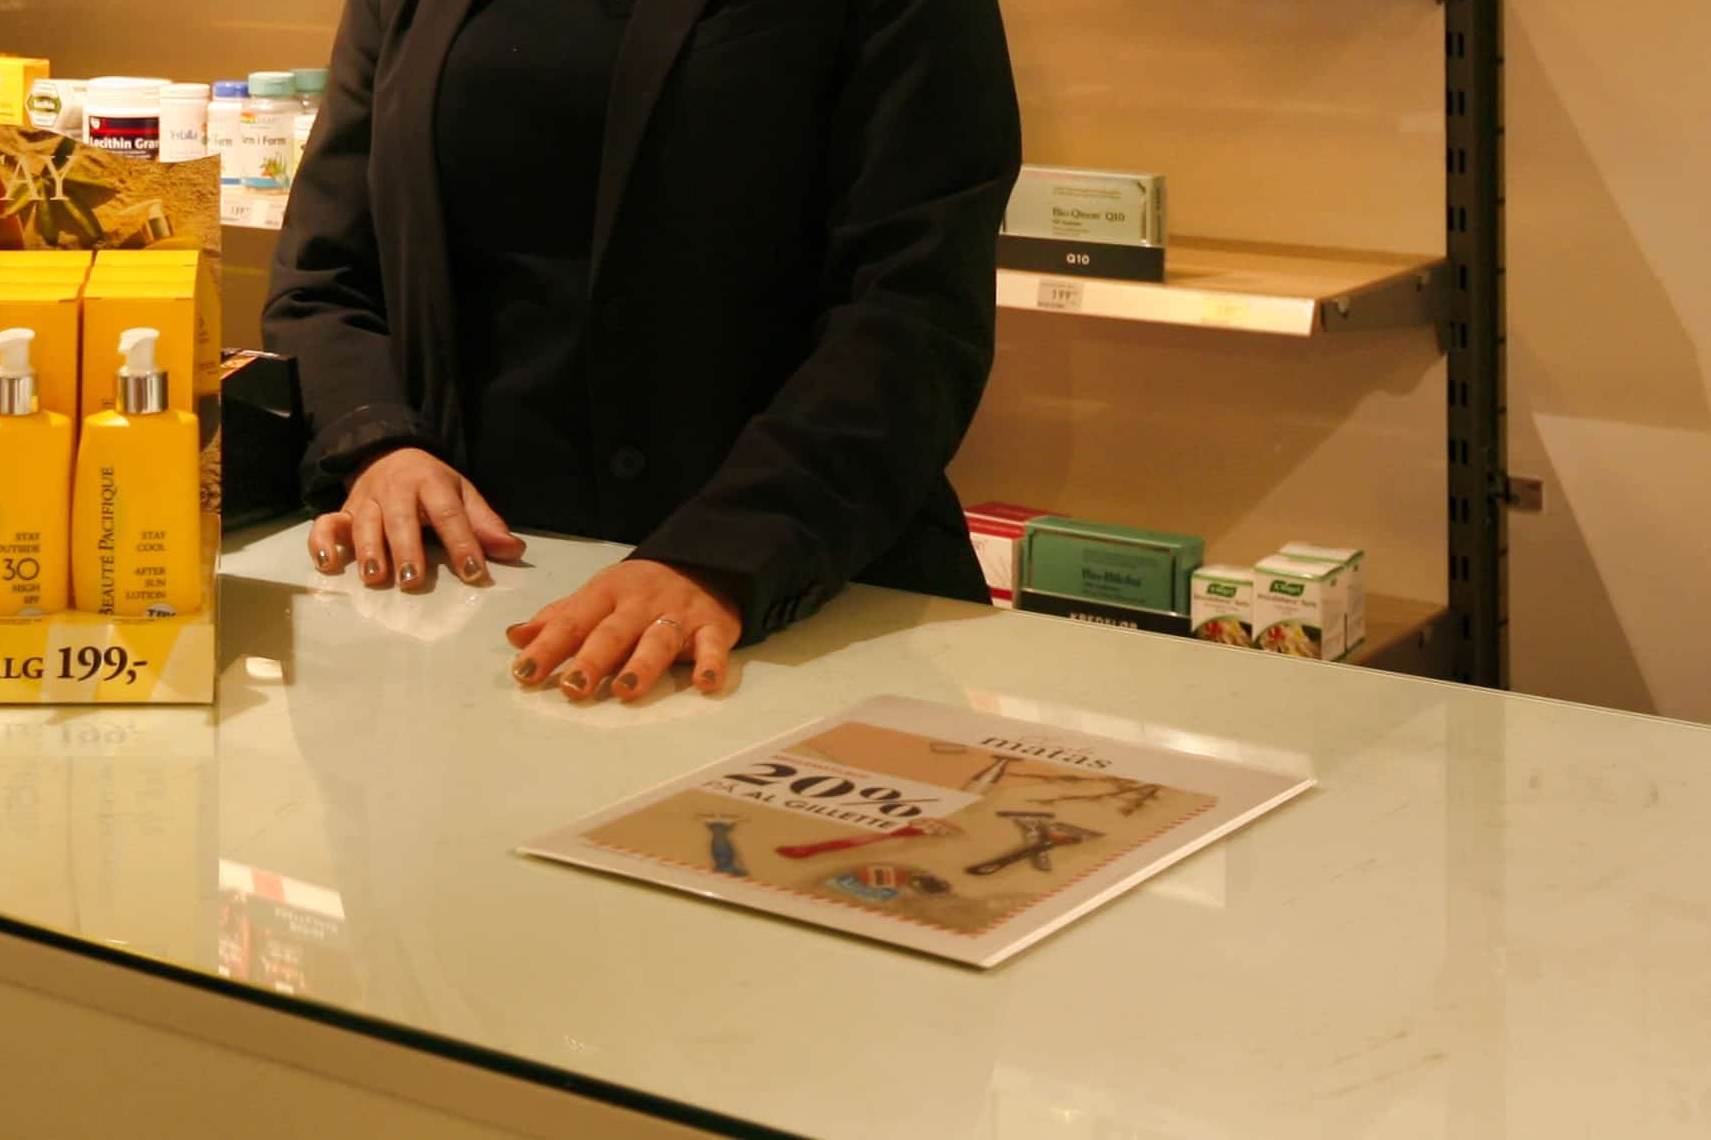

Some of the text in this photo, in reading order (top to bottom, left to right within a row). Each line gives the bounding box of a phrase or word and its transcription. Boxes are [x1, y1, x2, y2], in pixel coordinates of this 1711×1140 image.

[1066, 253, 1090, 265] Q10
[99, 467, 117, 551] PACIFIQUE
[16, 532, 40, 541] STAY
[142, 531, 166, 540] STAY
[2, 558, 40, 581] 30
[134, 567, 166, 576] AFTER
[12, 583, 40, 593] HIGH
[146, 579, 166, 588] SUN
[125, 591, 166, 600] LOTION
[56, 645, 148, 686] 199,-
[980, 738, 1114, 769] matas
[724, 762, 940, 818] 20%
[742, 791, 777, 804] AL
[785, 800, 897, 830] GILLETTE
